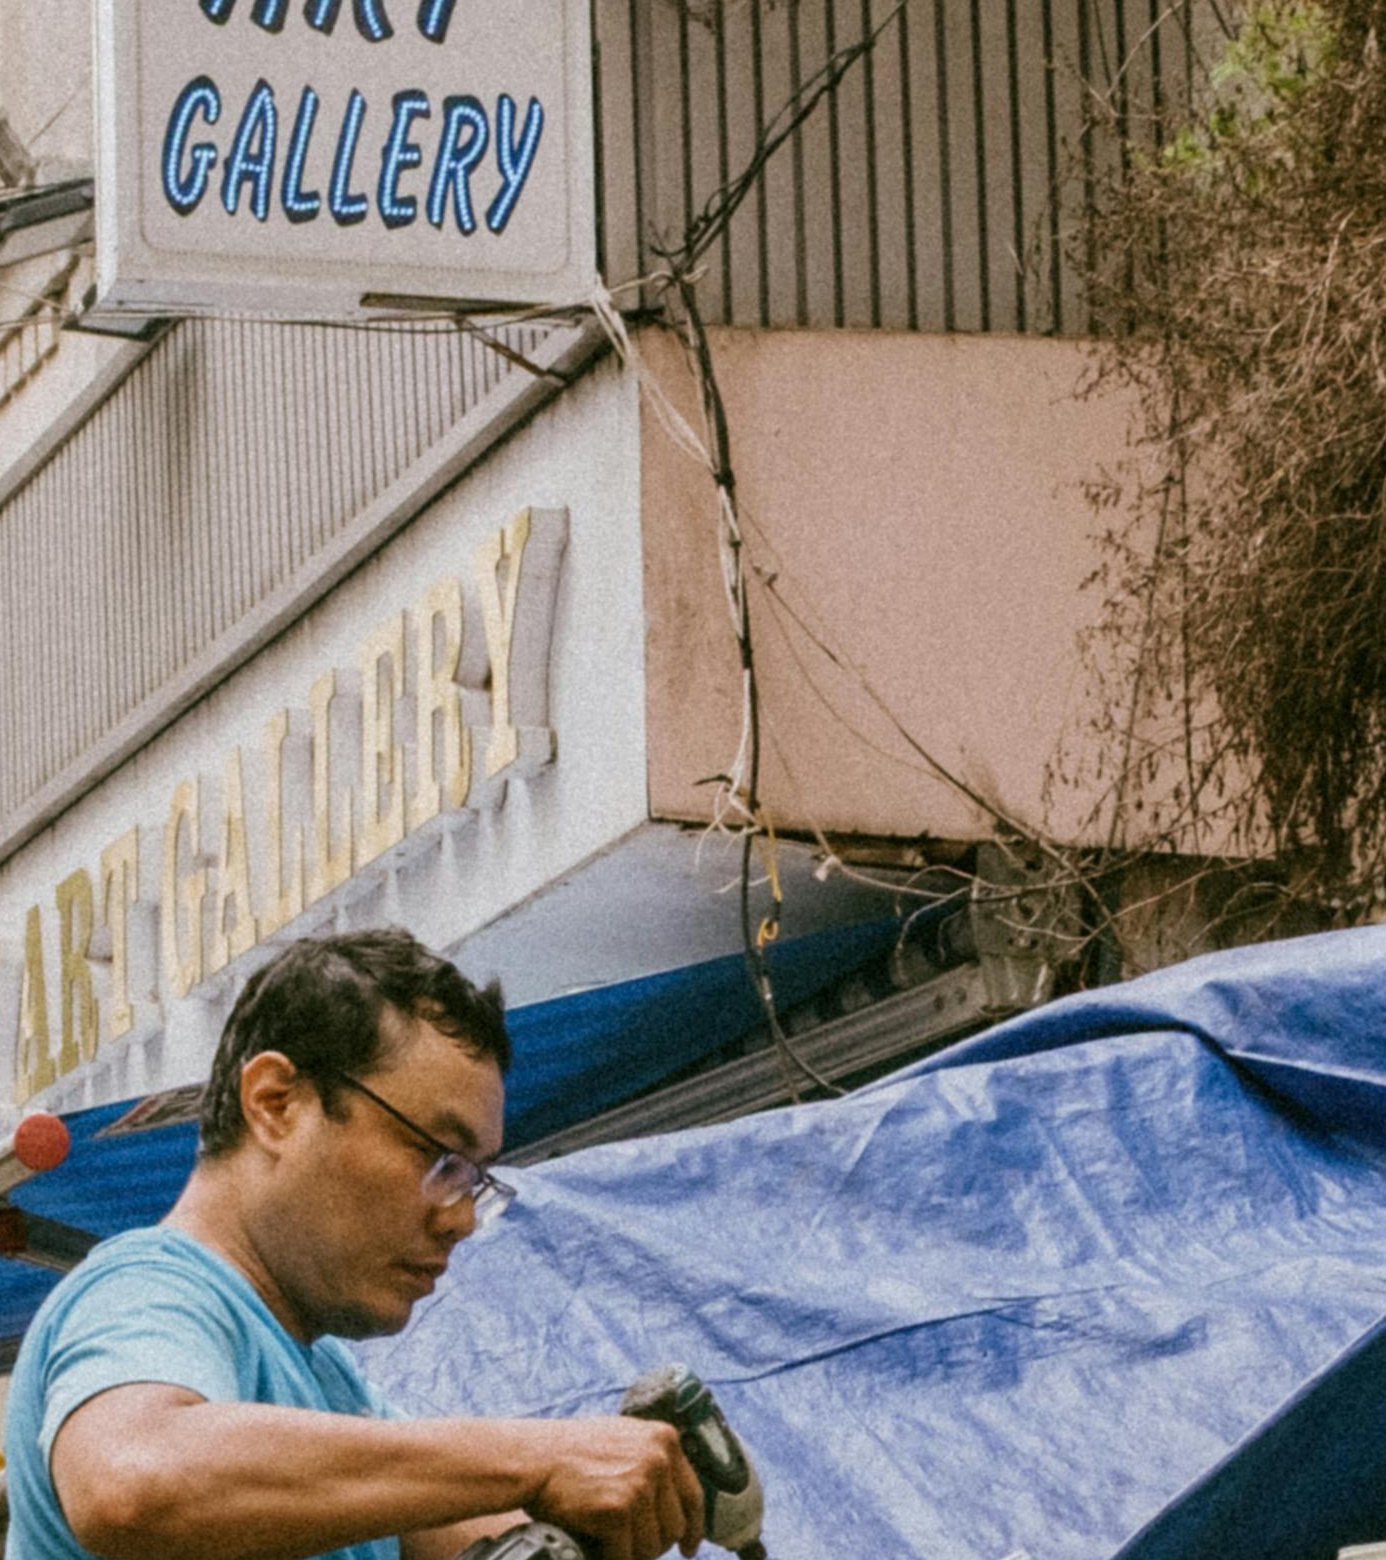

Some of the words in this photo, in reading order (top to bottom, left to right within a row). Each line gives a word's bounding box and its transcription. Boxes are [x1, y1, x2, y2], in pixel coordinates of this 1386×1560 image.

[162, 75, 544, 236] GALLERY
[16, 824, 139, 1104] ART
[160, 506, 538, 997] GALLERY
